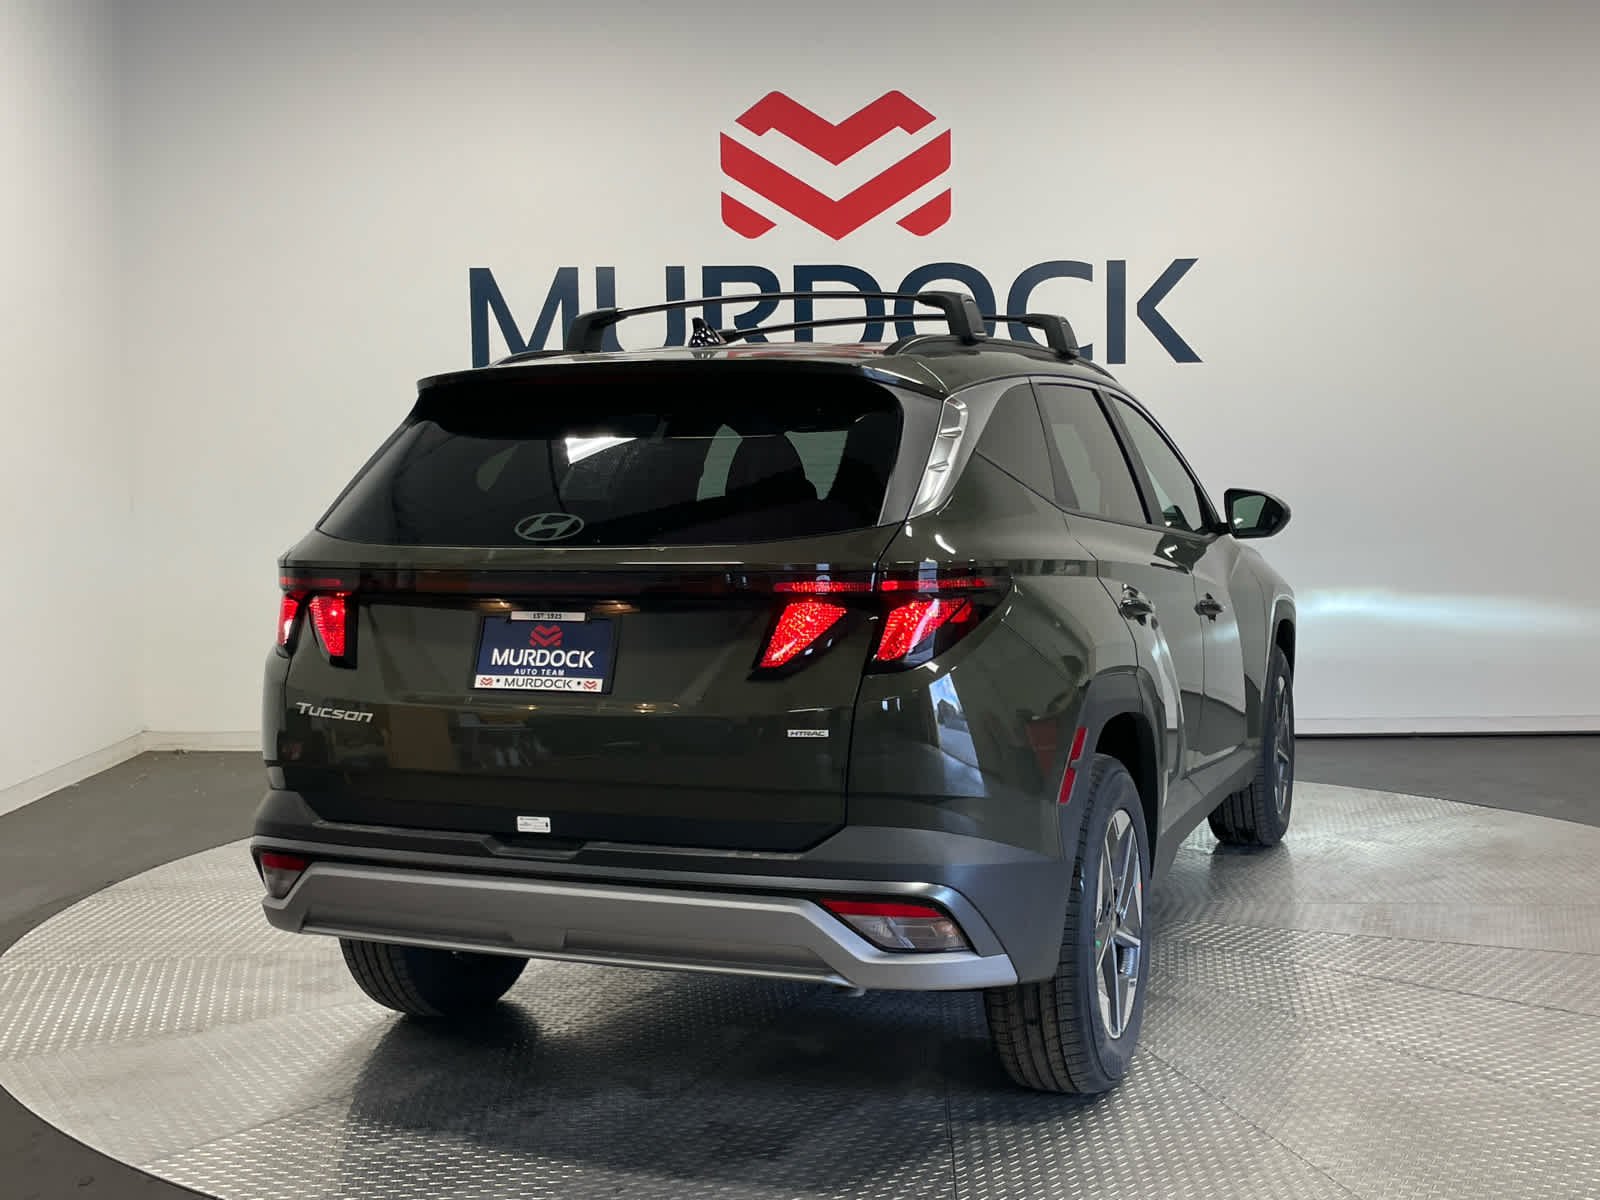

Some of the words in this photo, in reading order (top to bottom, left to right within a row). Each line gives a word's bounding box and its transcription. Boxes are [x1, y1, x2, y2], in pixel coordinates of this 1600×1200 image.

[469, 258, 1204, 367] MURDOCK
[491, 648, 595, 668] MURDOCK
[504, 677, 573, 689] MURDOCK
